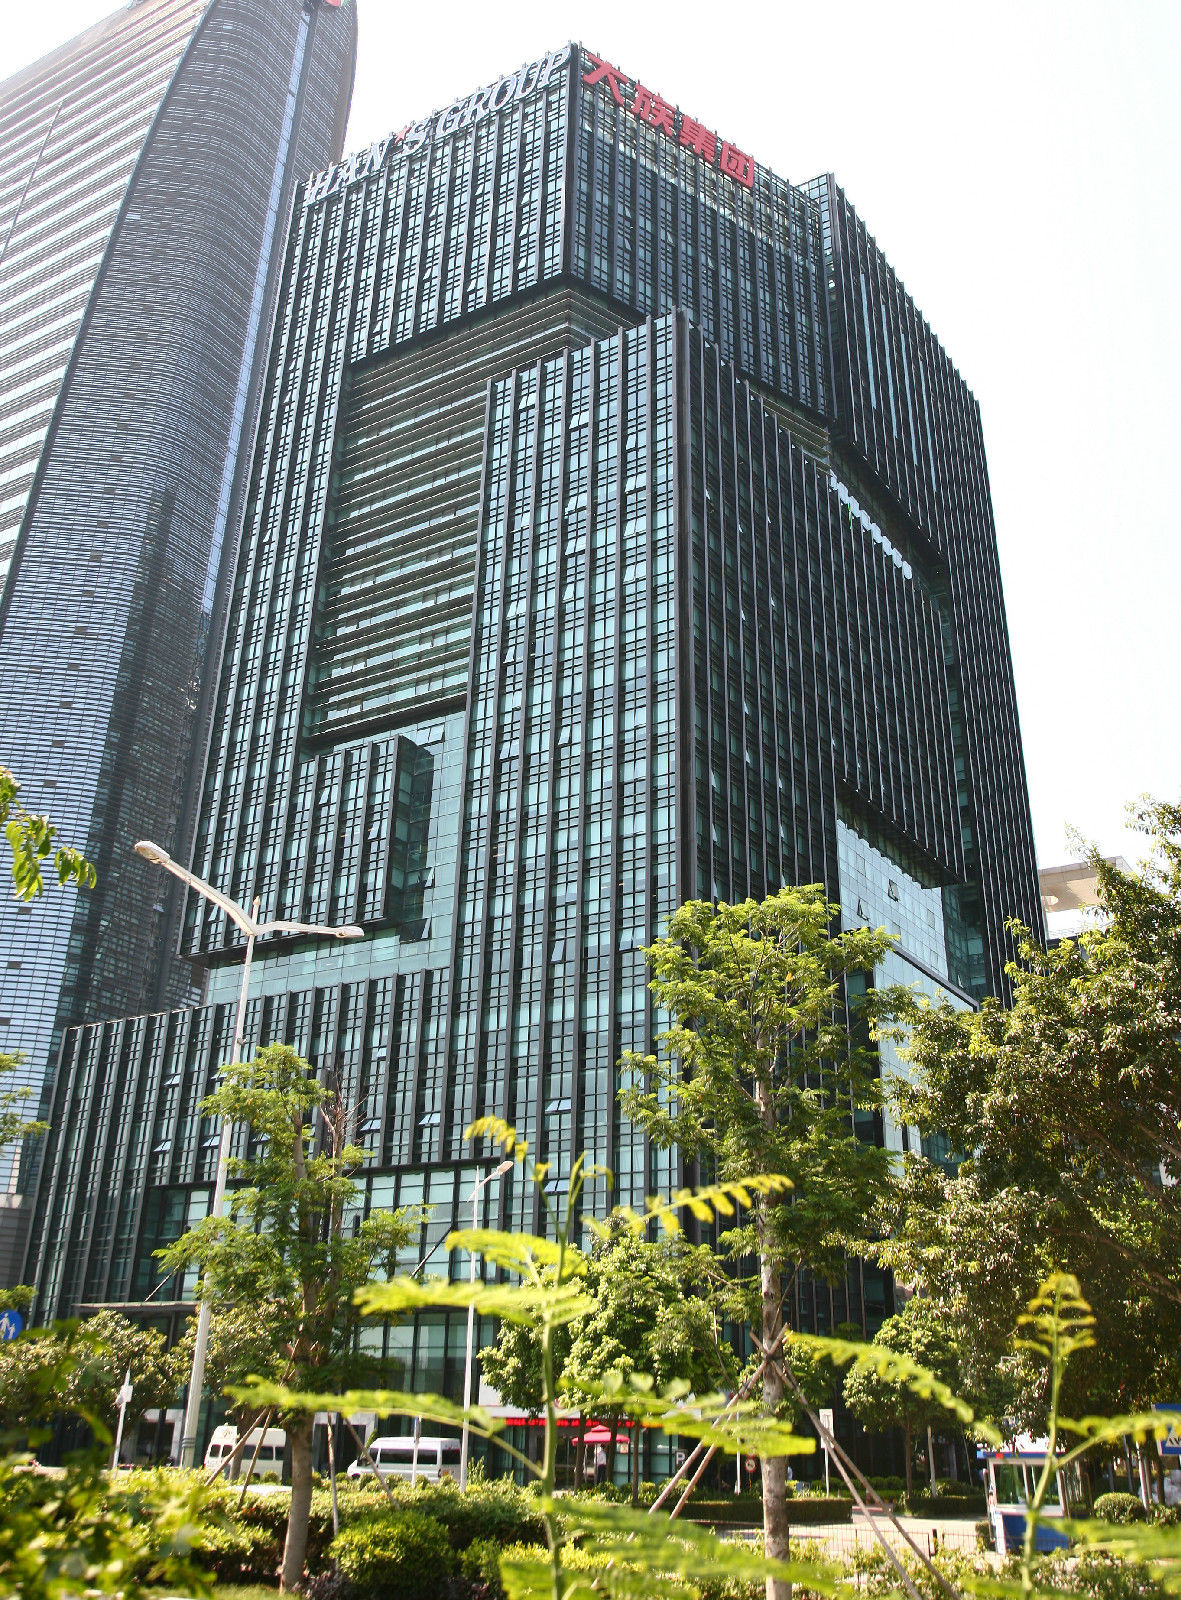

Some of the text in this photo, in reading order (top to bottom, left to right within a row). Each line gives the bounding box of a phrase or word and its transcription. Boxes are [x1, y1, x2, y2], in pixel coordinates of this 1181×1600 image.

[436, 48, 571, 138] GROUP
[583, 52, 755, 188] 大族集团
